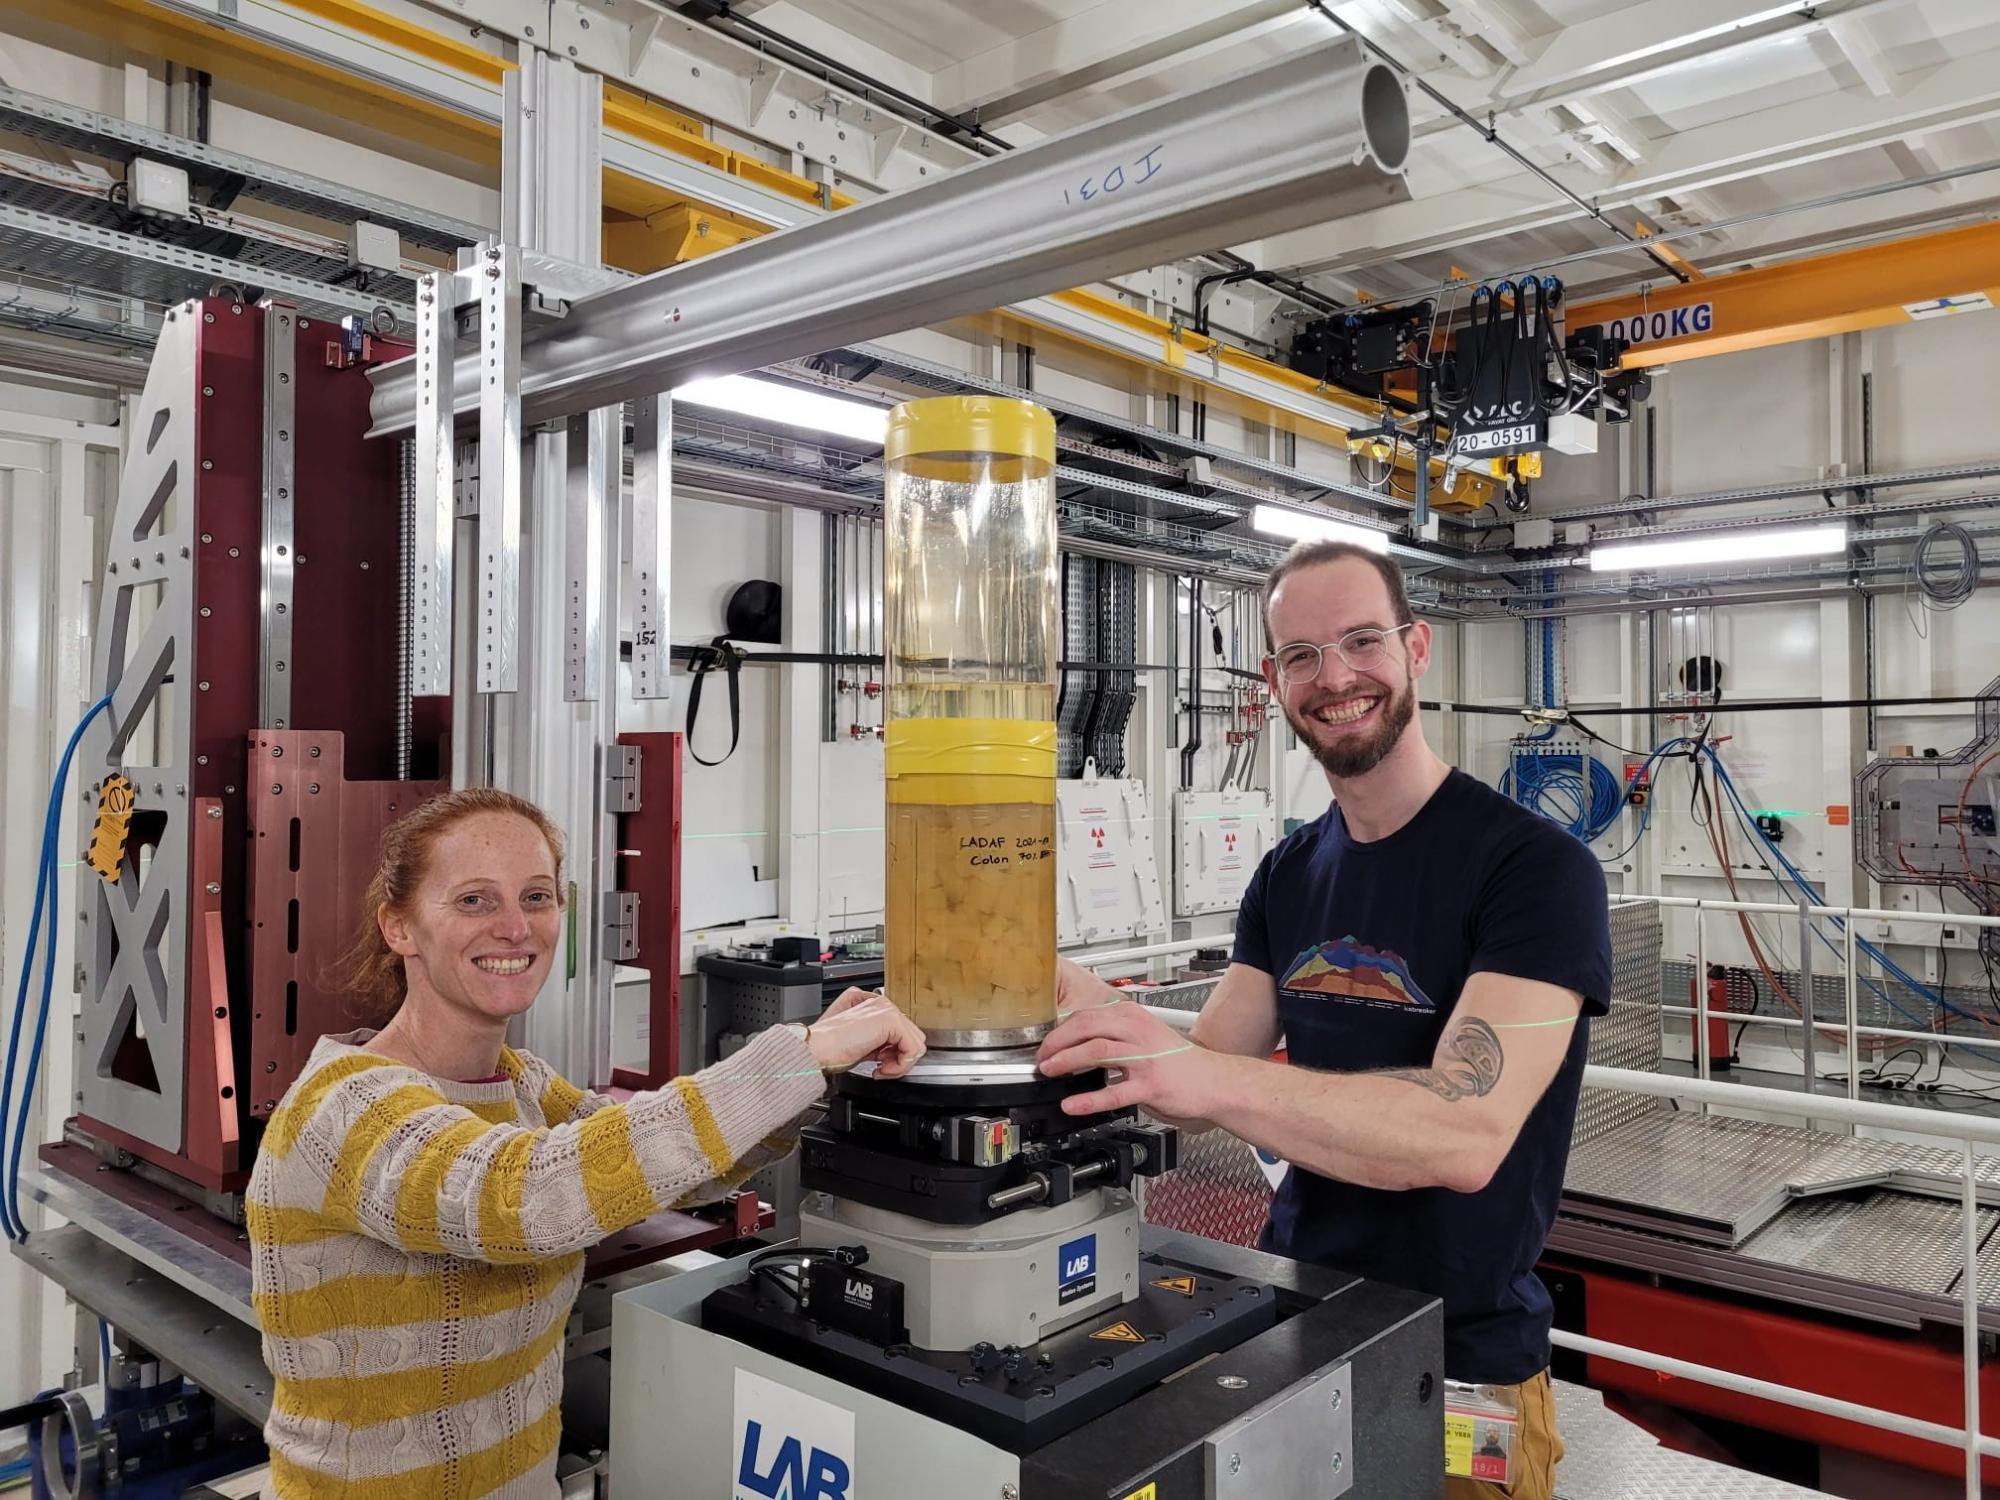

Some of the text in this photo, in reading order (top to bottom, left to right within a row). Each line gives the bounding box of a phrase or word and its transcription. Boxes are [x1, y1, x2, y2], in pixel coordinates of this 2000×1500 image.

[1064, 145, 1163, 205] ID31
[1610, 304, 1711, 343] 000KG
[960, 836, 1006, 850] LADAF
[970, 854, 1009, 866] Colon
[1066, 1255, 1089, 1278] LAB
[845, 1278, 874, 1301] LAB
[739, 1419, 850, 1500] LAB
